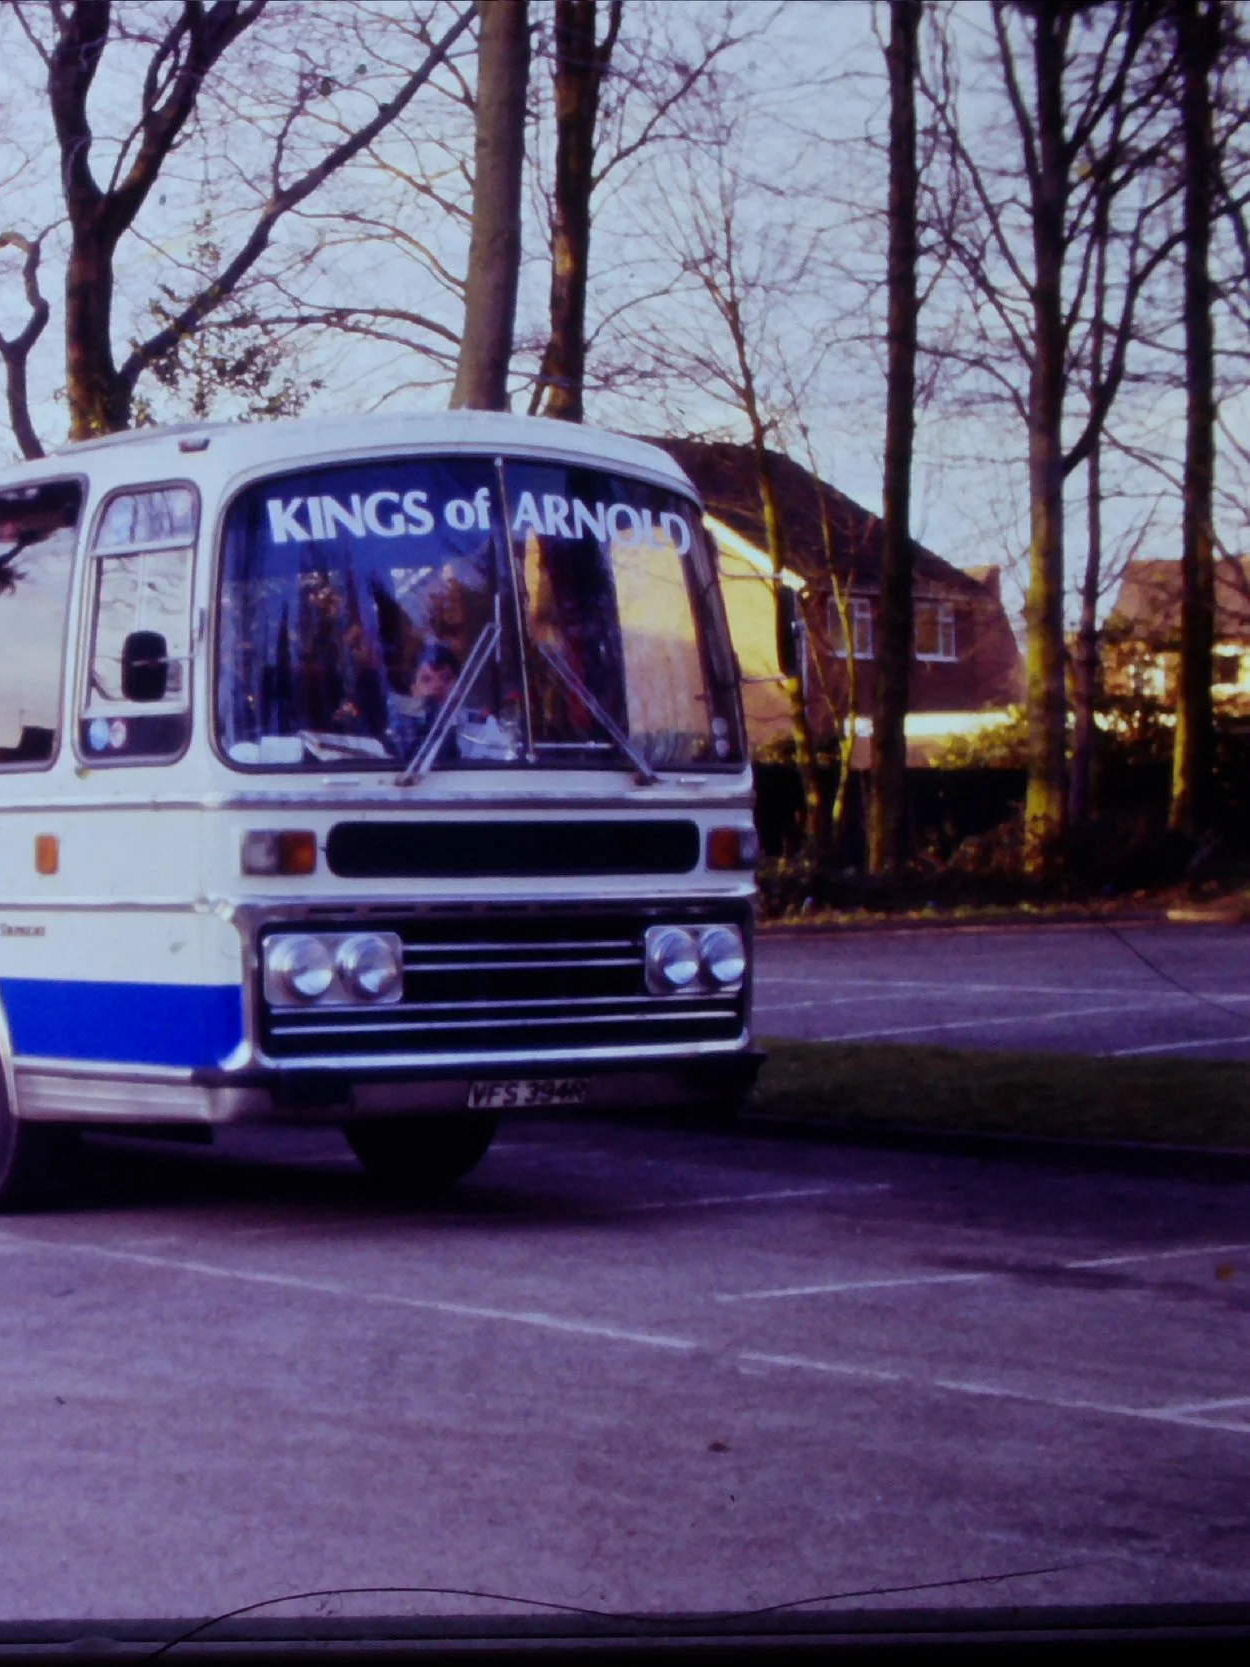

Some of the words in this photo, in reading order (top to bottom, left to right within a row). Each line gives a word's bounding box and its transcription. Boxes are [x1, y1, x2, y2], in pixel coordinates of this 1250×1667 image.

[267, 491, 434, 543] KINGS
[444, 487, 490, 530] of
[513, 491, 691, 555] ARNOLD
